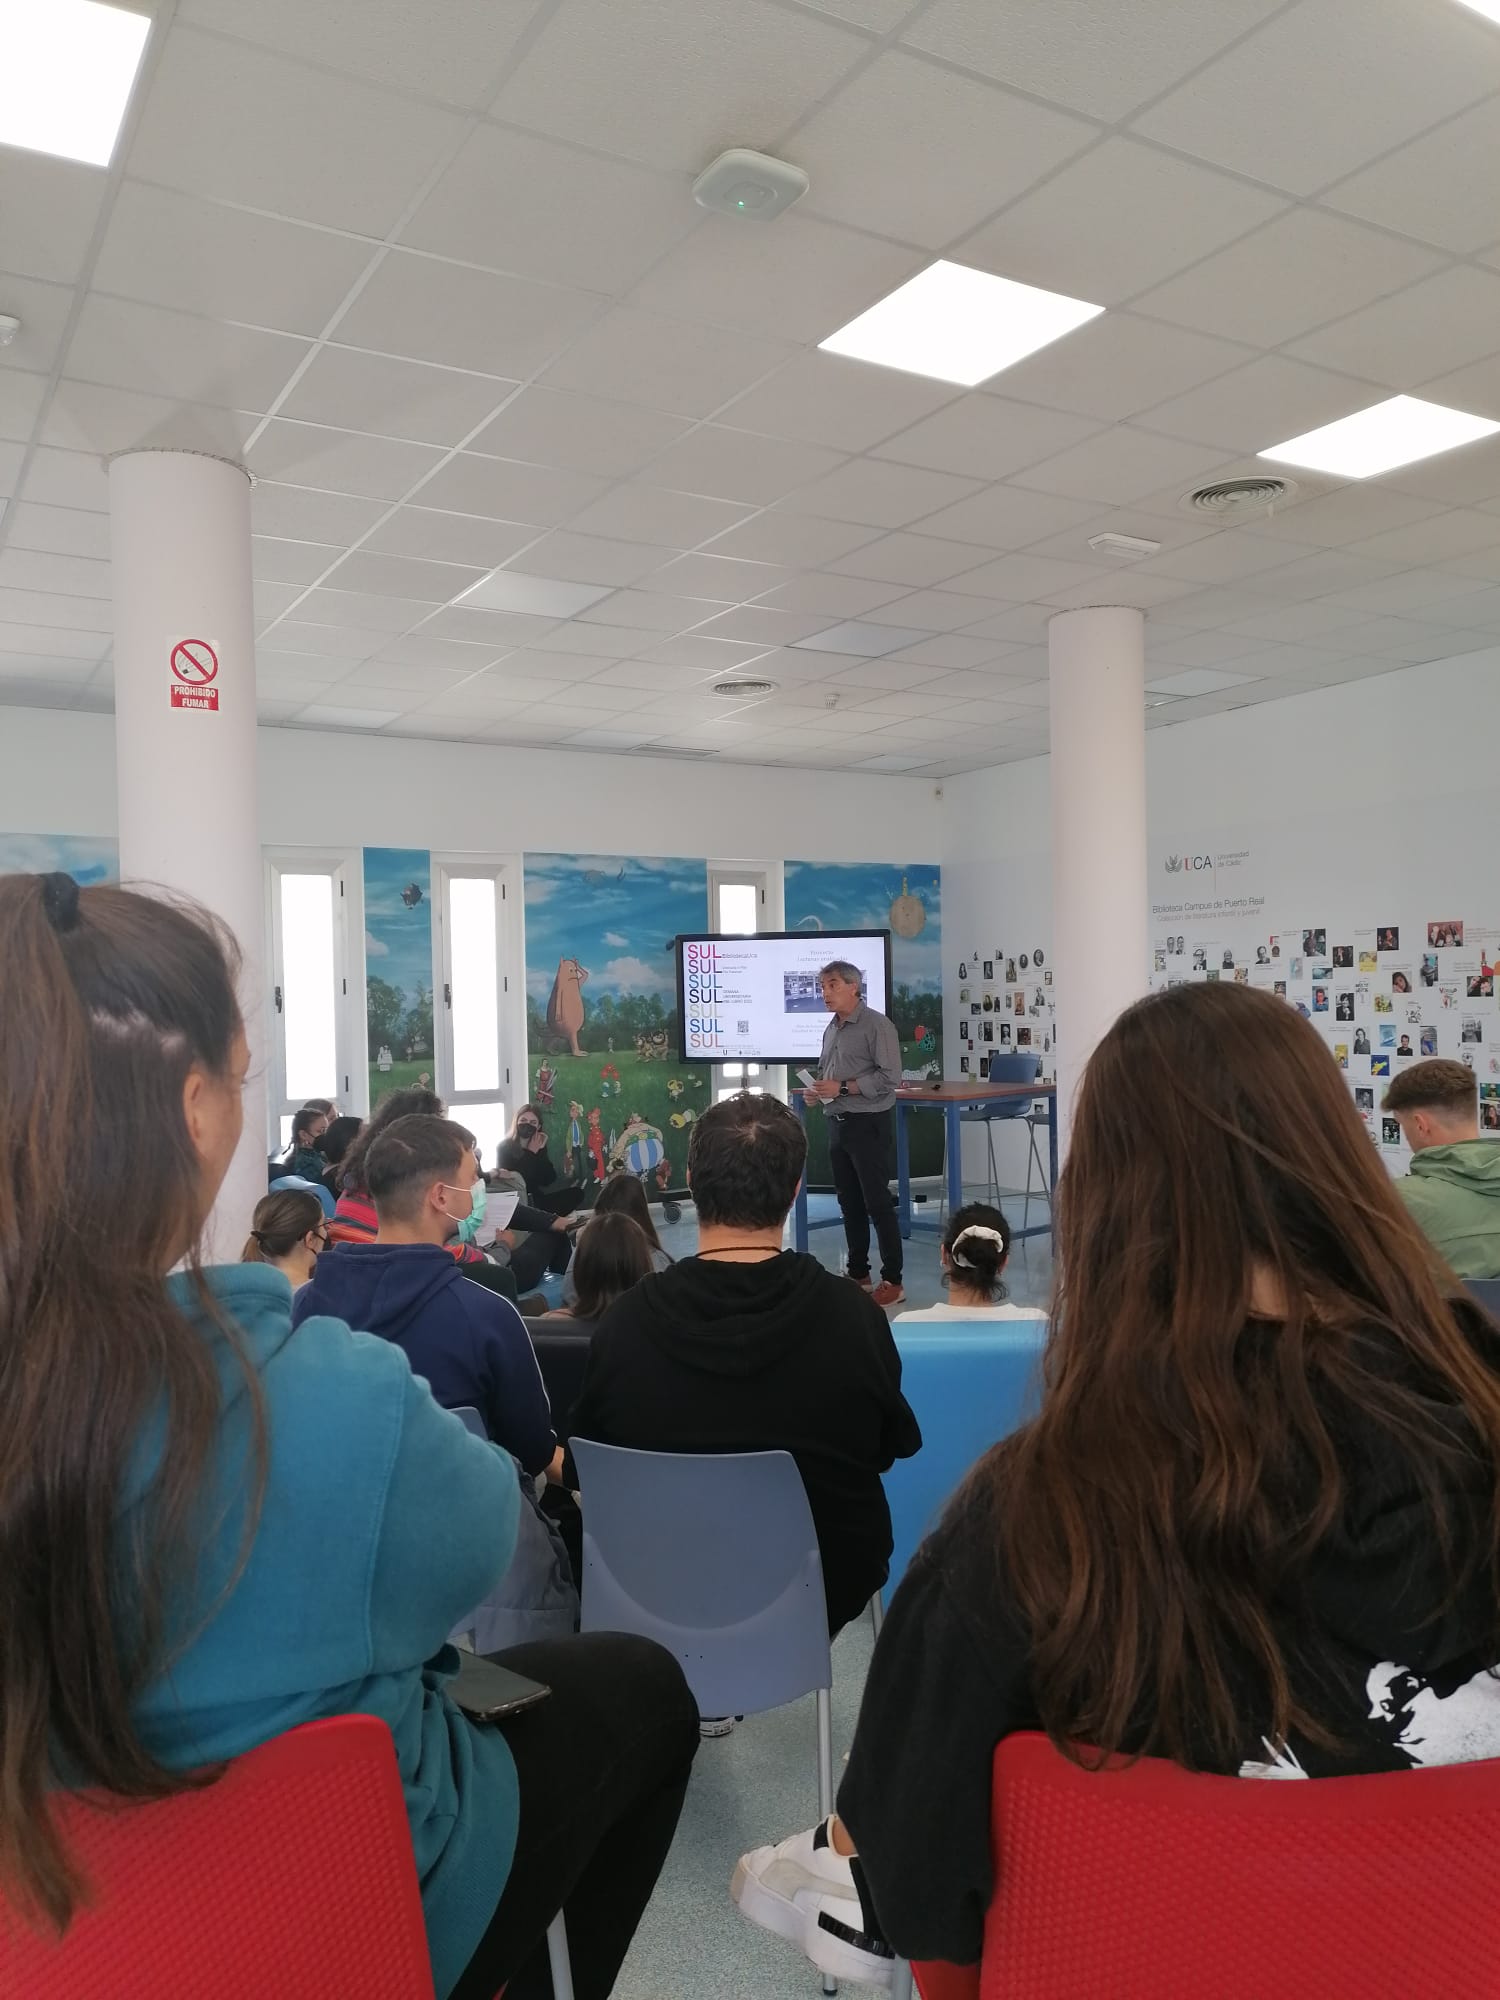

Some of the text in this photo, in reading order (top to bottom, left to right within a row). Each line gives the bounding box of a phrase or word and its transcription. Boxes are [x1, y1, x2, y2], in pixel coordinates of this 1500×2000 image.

[174, 686, 216, 698] PROHIBIDO
[182, 698, 209, 708] FUMAR
[1184, 855, 1213, 871] UCA
[1152, 896, 1265, 914] Biblioteca Campus de Puerto Real
[688, 944, 722, 959] SUL
[688, 959, 722, 974] SUL
[689, 974, 723, 988] SUL
[689, 989, 723, 1003] SUL
[690, 1004, 724, 1018] SUL
[690, 1019, 724, 1033] SUL
[690, 1033, 724, 1048] SUL
